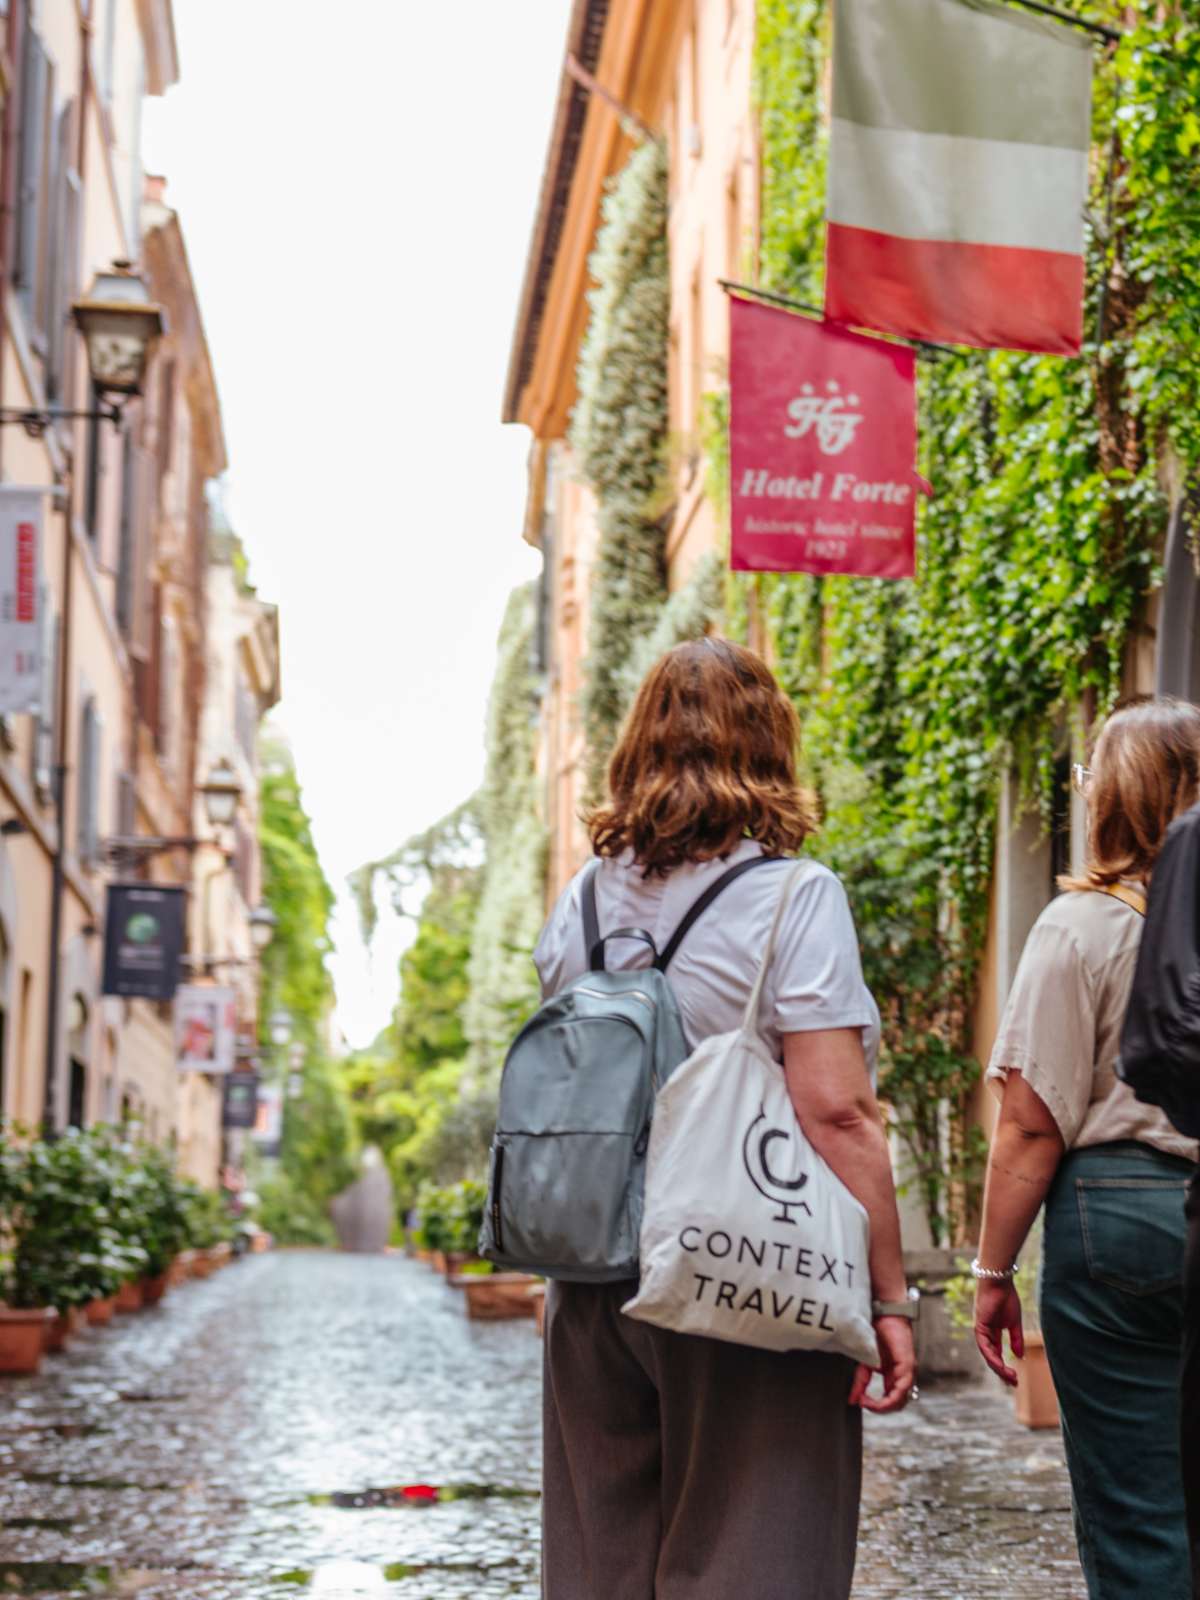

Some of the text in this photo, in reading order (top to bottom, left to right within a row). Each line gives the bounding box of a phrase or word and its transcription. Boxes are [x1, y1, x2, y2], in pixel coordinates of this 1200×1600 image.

[740, 469, 910, 504] Hotel Forte
[679, 1226, 855, 1288] CONTEXT
[694, 1273, 834, 1332] TRAVEL
